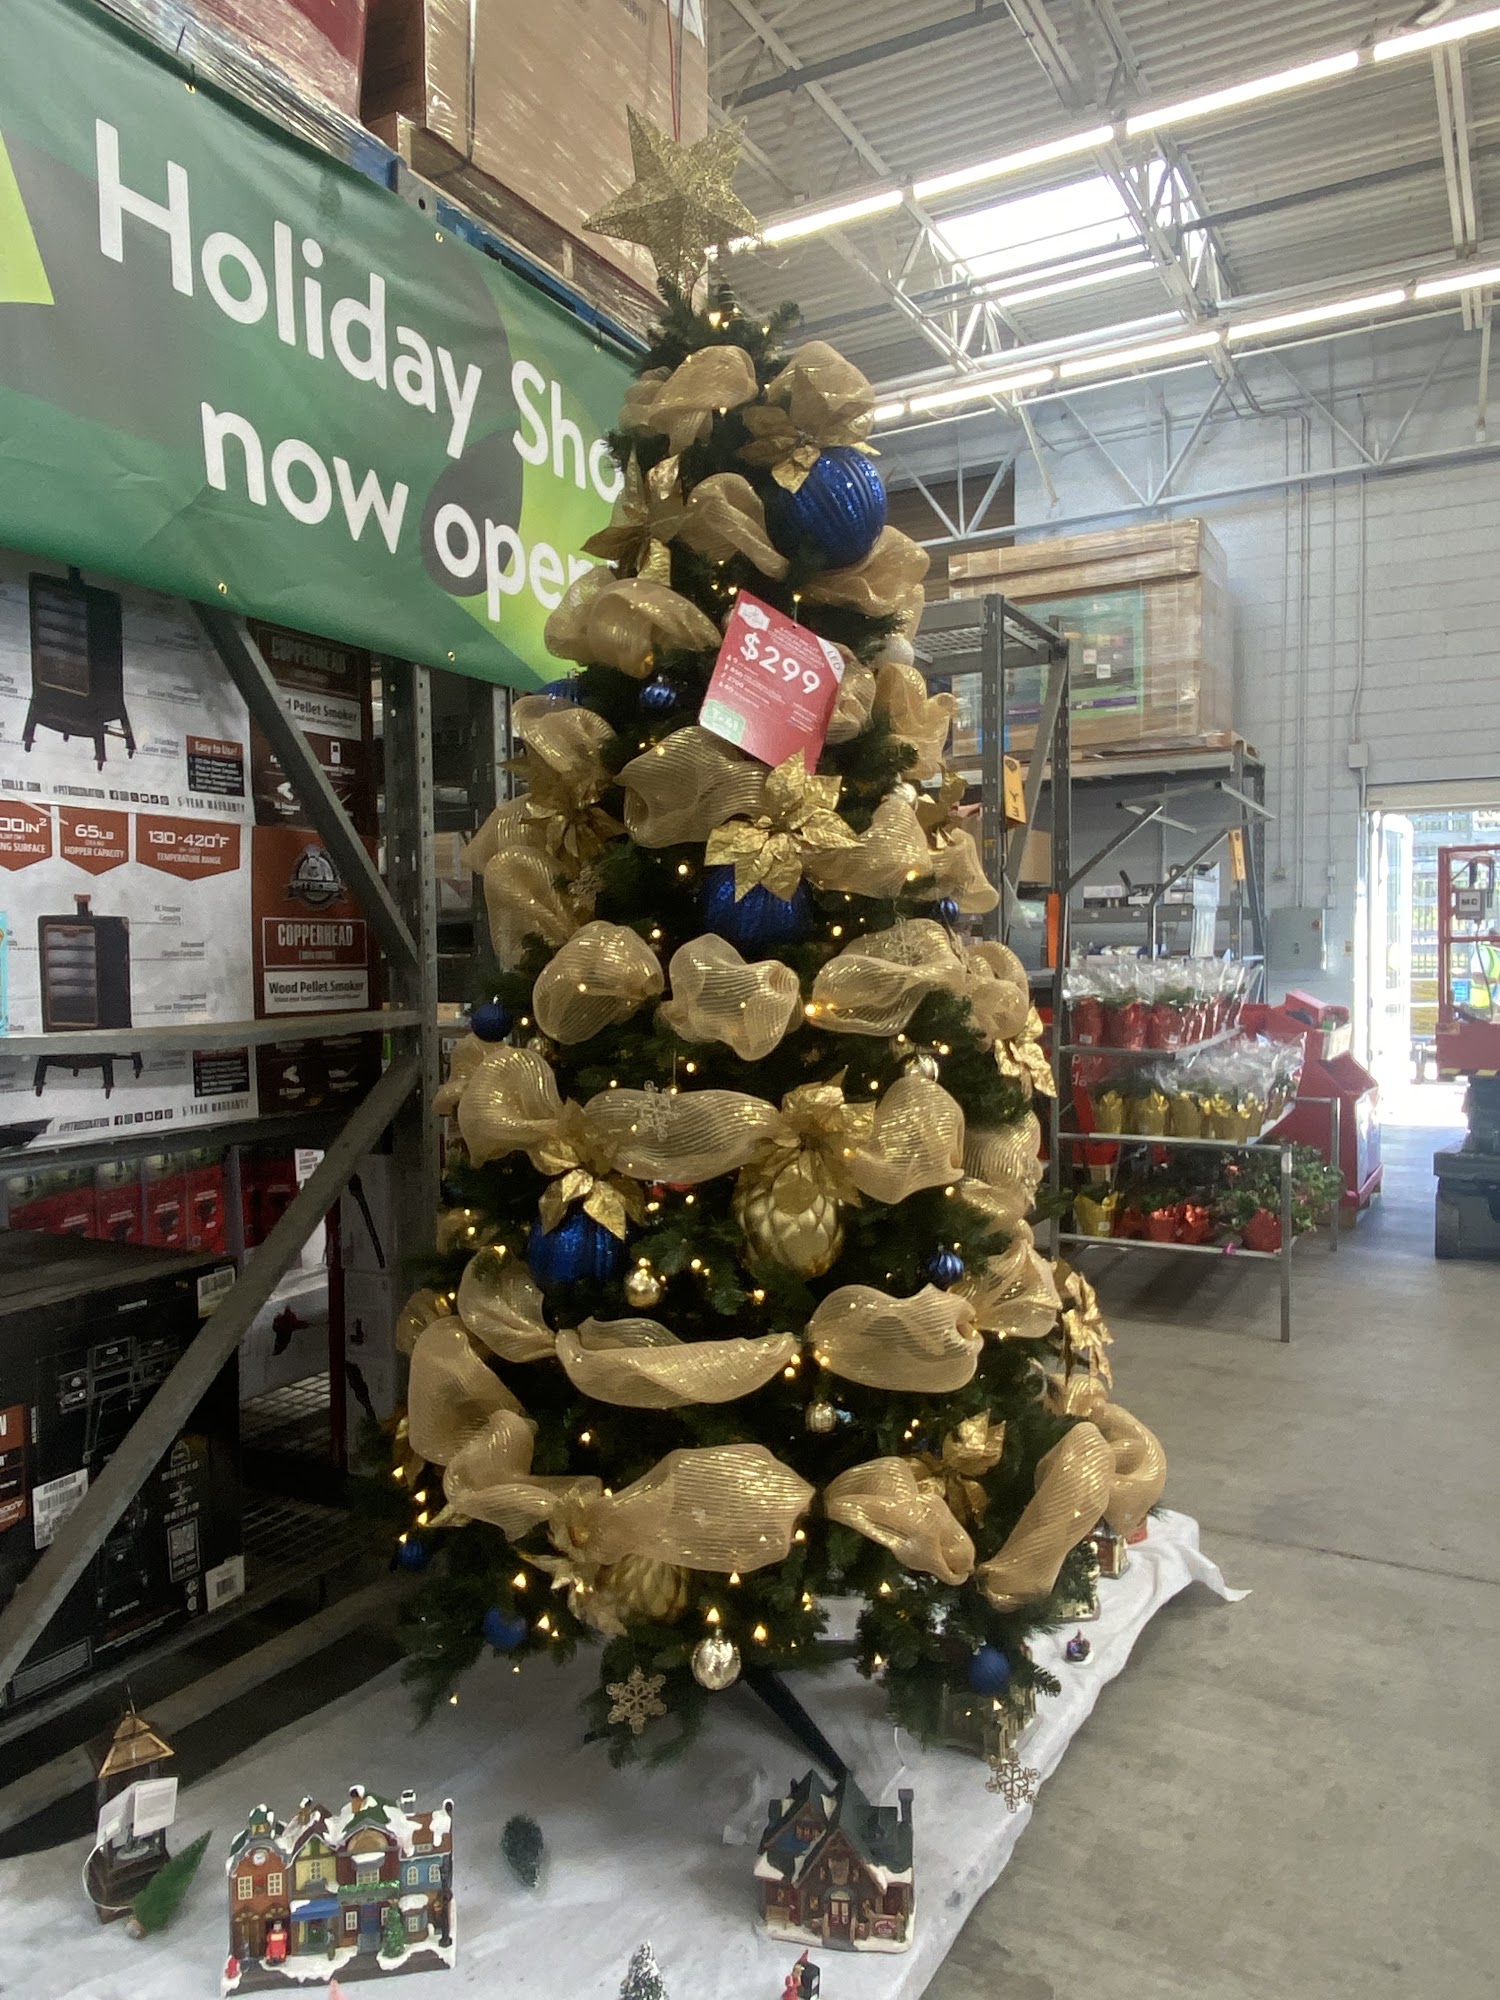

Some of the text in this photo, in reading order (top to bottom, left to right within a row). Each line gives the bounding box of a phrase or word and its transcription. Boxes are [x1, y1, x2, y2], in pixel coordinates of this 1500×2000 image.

[96, 118, 625, 504] Holiday Sho
[201, 401, 409, 555] now
[740, 632, 820, 694] $299
[827, 649, 842, 671] LED
[293, 699, 321, 715] Pellet
[323, 704, 357, 721] Smoker
[13, 842, 46, 854] SURFACE
[64, 845, 125, 859] HOPPER CAPACITY
[157, 852, 200, 864] TEMPERATURE
[277, 923, 354, 947] COPPERHEAD
[268, 979, 365, 994] Wood Pellet Smoker
